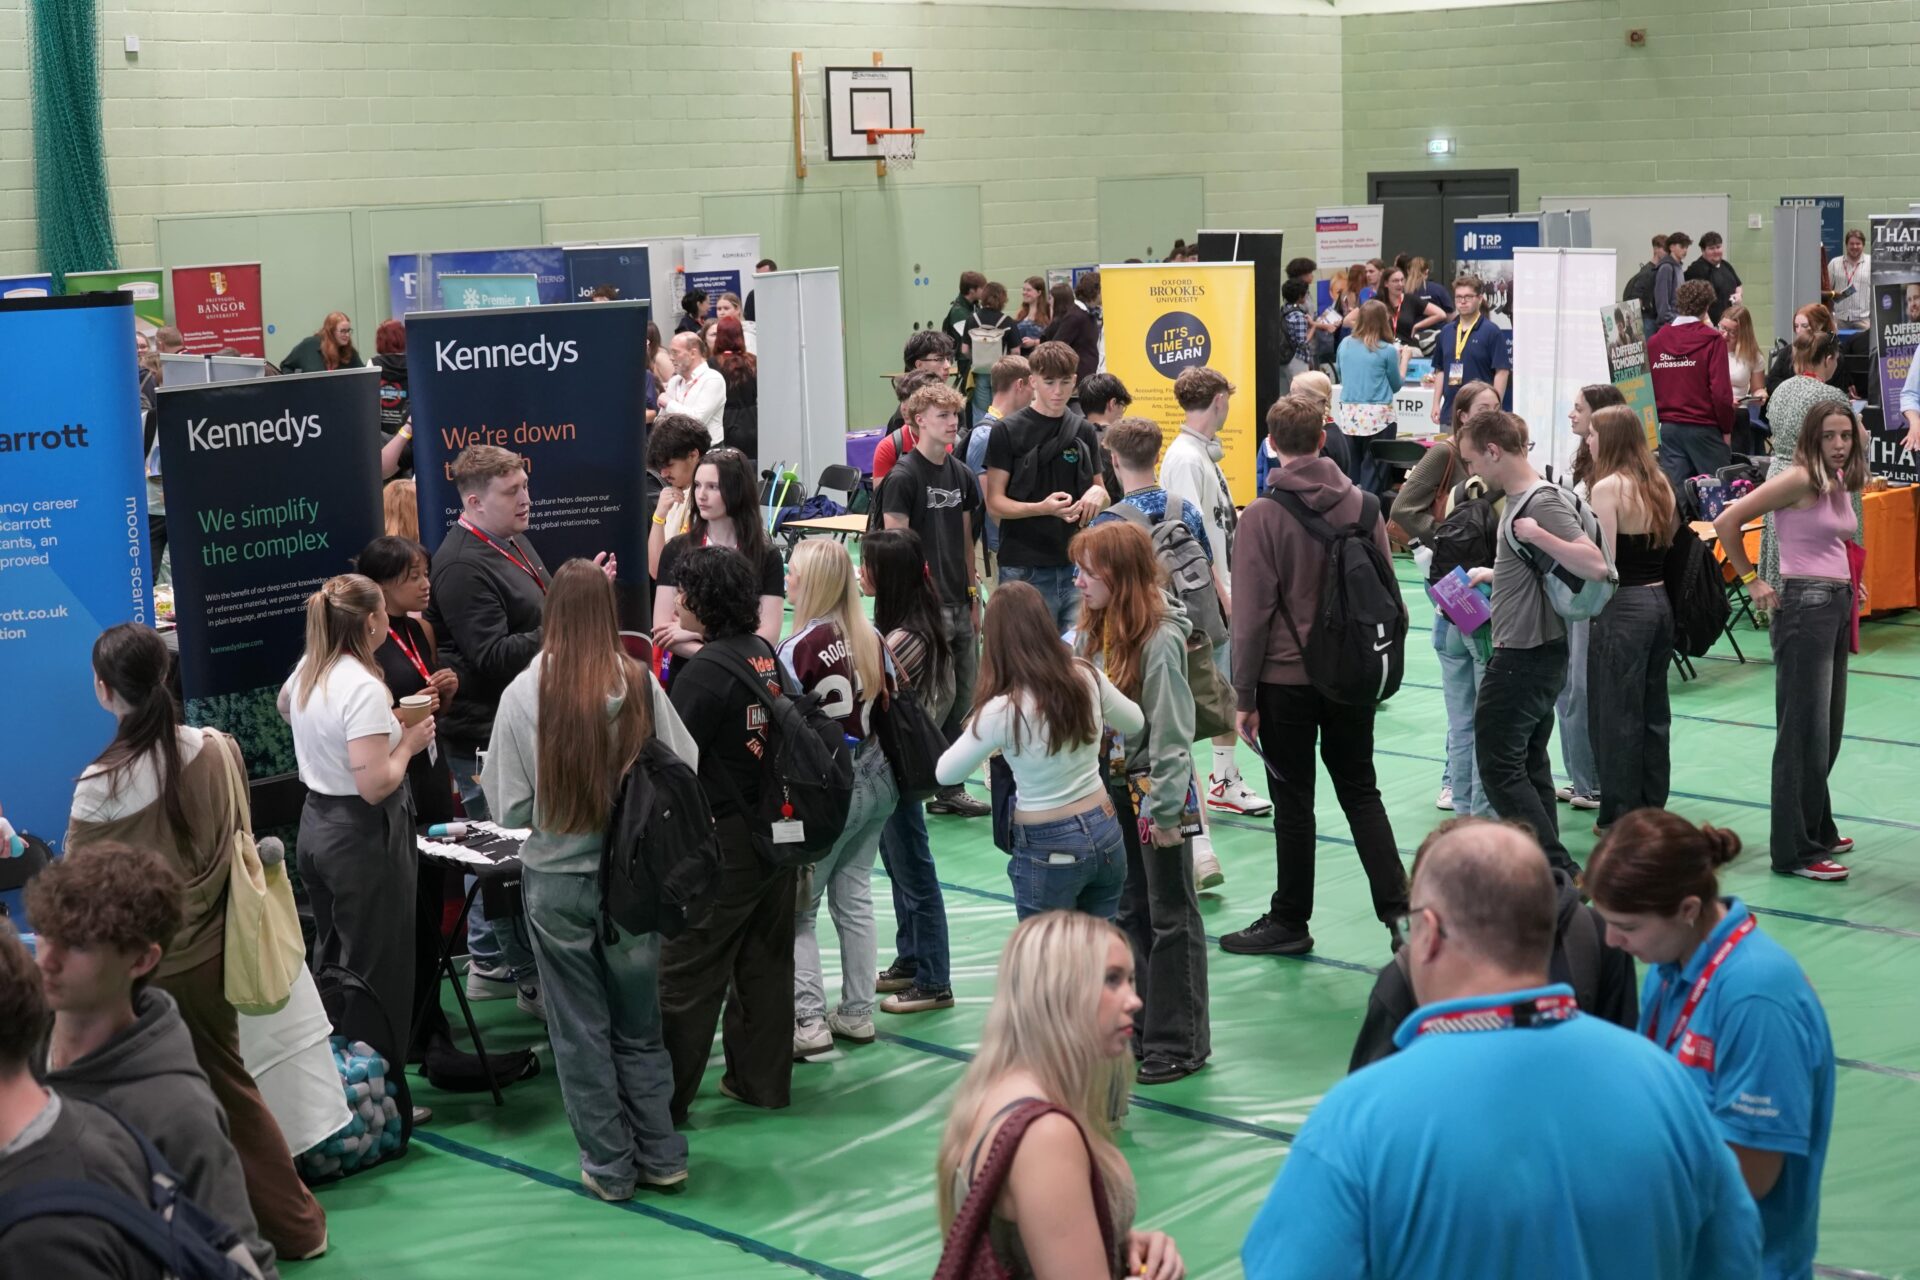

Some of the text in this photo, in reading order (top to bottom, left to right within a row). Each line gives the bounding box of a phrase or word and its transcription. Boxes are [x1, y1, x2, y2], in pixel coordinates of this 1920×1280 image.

[1479, 234, 1502, 246] TRP
[1873, 225, 1920, 243] THAT
[578, 286, 596, 298] Joi
[1150, 285, 1205, 297] BROOKES
[481, 294, 516, 305] Premier
[1156, 296, 1199, 304] UNIVERSITY
[197, 302, 246, 314] BANGOR
[1884, 324, 1892, 336] A
[1151, 334, 1205, 354] TIME TO
[435, 333, 579, 372] Kennedys
[1159, 346, 1202, 365] LEARN
[1612, 352, 1645, 371] TOMORROW
[1653, 359, 1696, 369] Ambassador
[1396, 399, 1423, 412] TRP
[187, 408, 322, 451] Kennedys
[514, 421, 576, 444] down
[1870, 436, 1916, 467] THA
[1882, 470, 1919, 482] TALENT
[33, 499, 79, 511] career
[534, 497, 556, 506] culture
[557, 496, 574, 505] helps
[575, 495, 598, 504] deepen
[197, 497, 319, 533] We simplify
[552, 508, 580, 516] extension
[41, 535, 58, 547] an
[201, 529, 329, 566] the complex
[125, 496, 145, 624] moore-scarro
